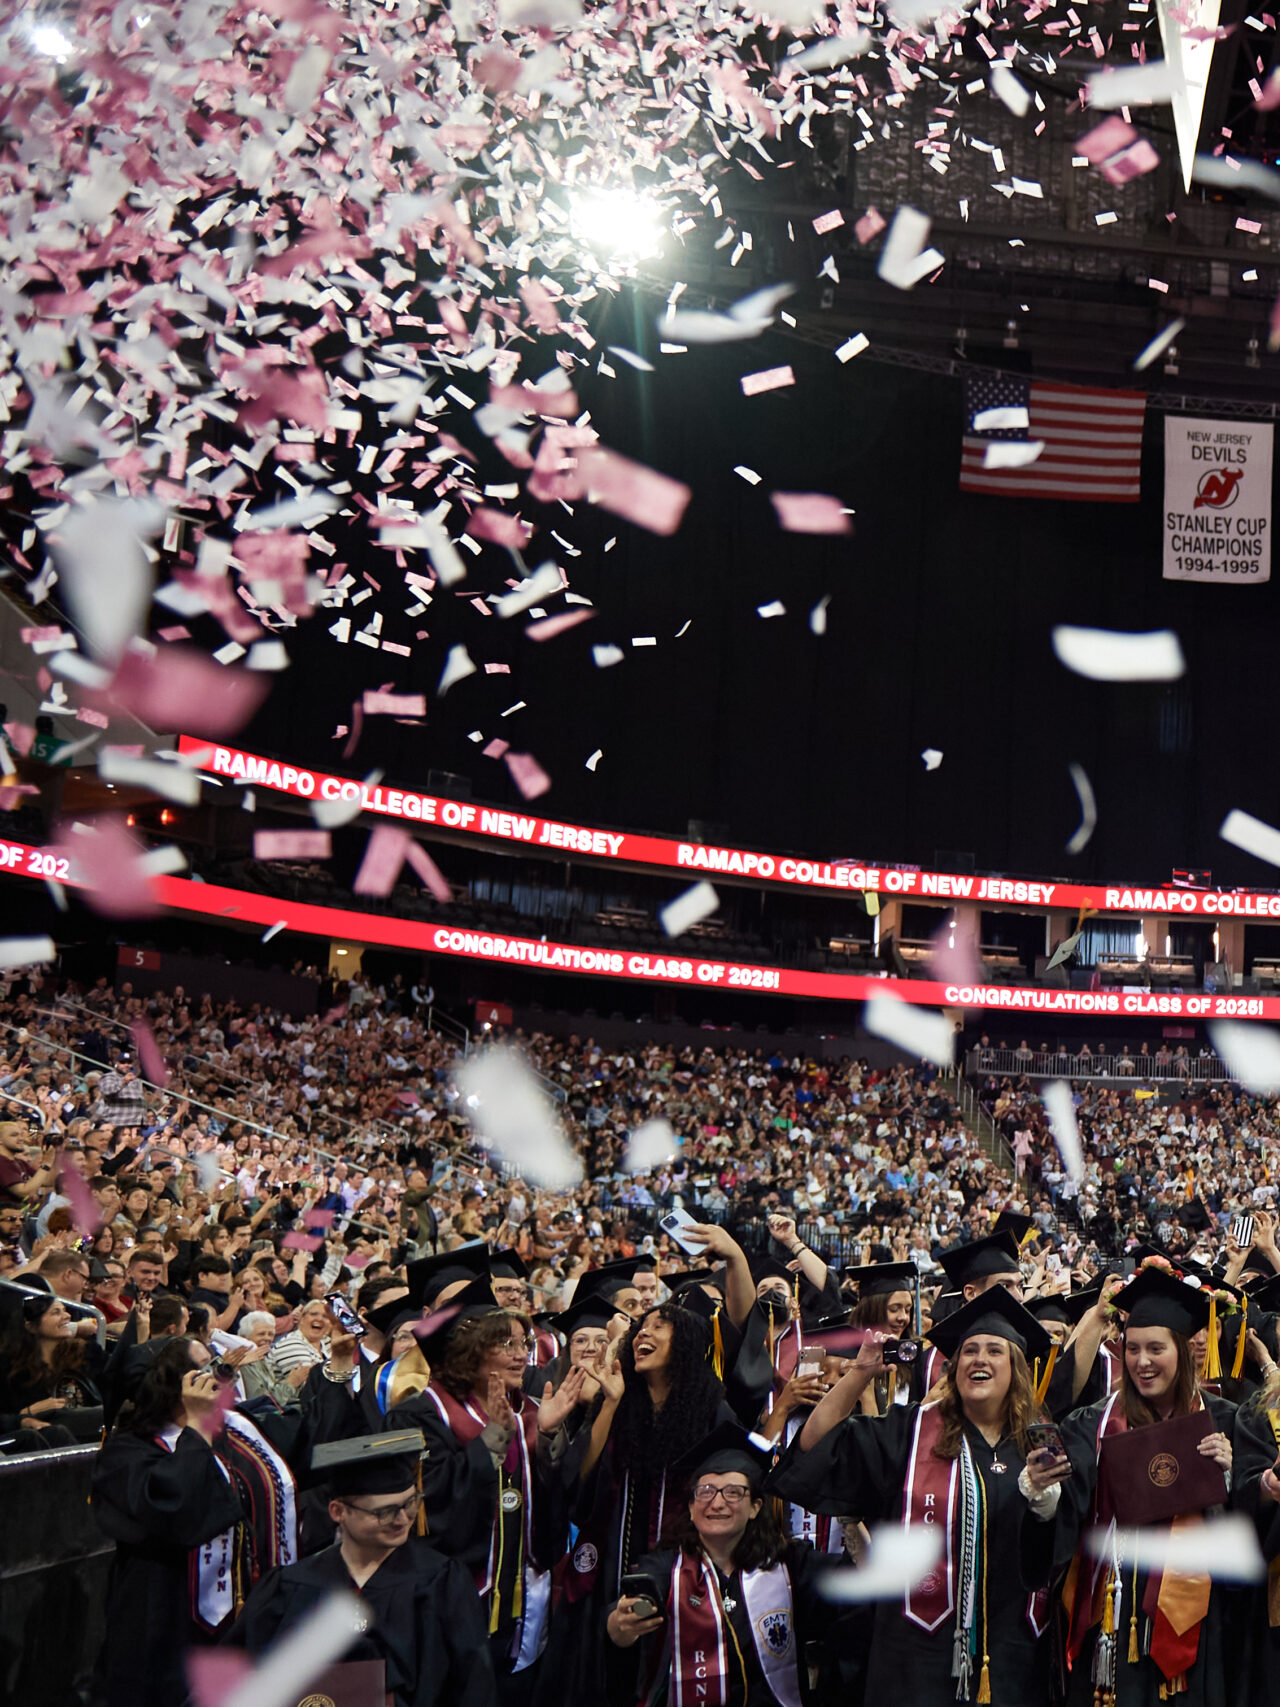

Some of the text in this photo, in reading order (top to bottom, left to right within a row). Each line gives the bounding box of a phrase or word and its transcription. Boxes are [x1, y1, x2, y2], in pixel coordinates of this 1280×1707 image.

[1187, 431, 1252, 445] NEW JERSEY
[1191, 445, 1247, 464] DEVILS
[1167, 512, 1267, 536] STANLEY CUP
[1171, 534, 1263, 556] CHAMPIONS
[1175, 556, 1260, 574] 1994-1995
[214, 747, 625, 855] RAMAPO COLLEGE OF NEW JERSEY
[26, 851, 71, 880] 202
[677, 844, 1056, 904] RAMAPO COLLEGE OF NEW JERSEY
[1106, 889, 1197, 912] RAMAPO
[135, 951, 144, 965] 5
[434, 929, 780, 989] CONGRATULATIONS CLASS OF 2025!
[945, 986, 1264, 1015] CONGRATULATIONS CLASS OF 2025!
[490, 1008, 498, 1021] 4
[763, 1613, 786, 1628] EMT
